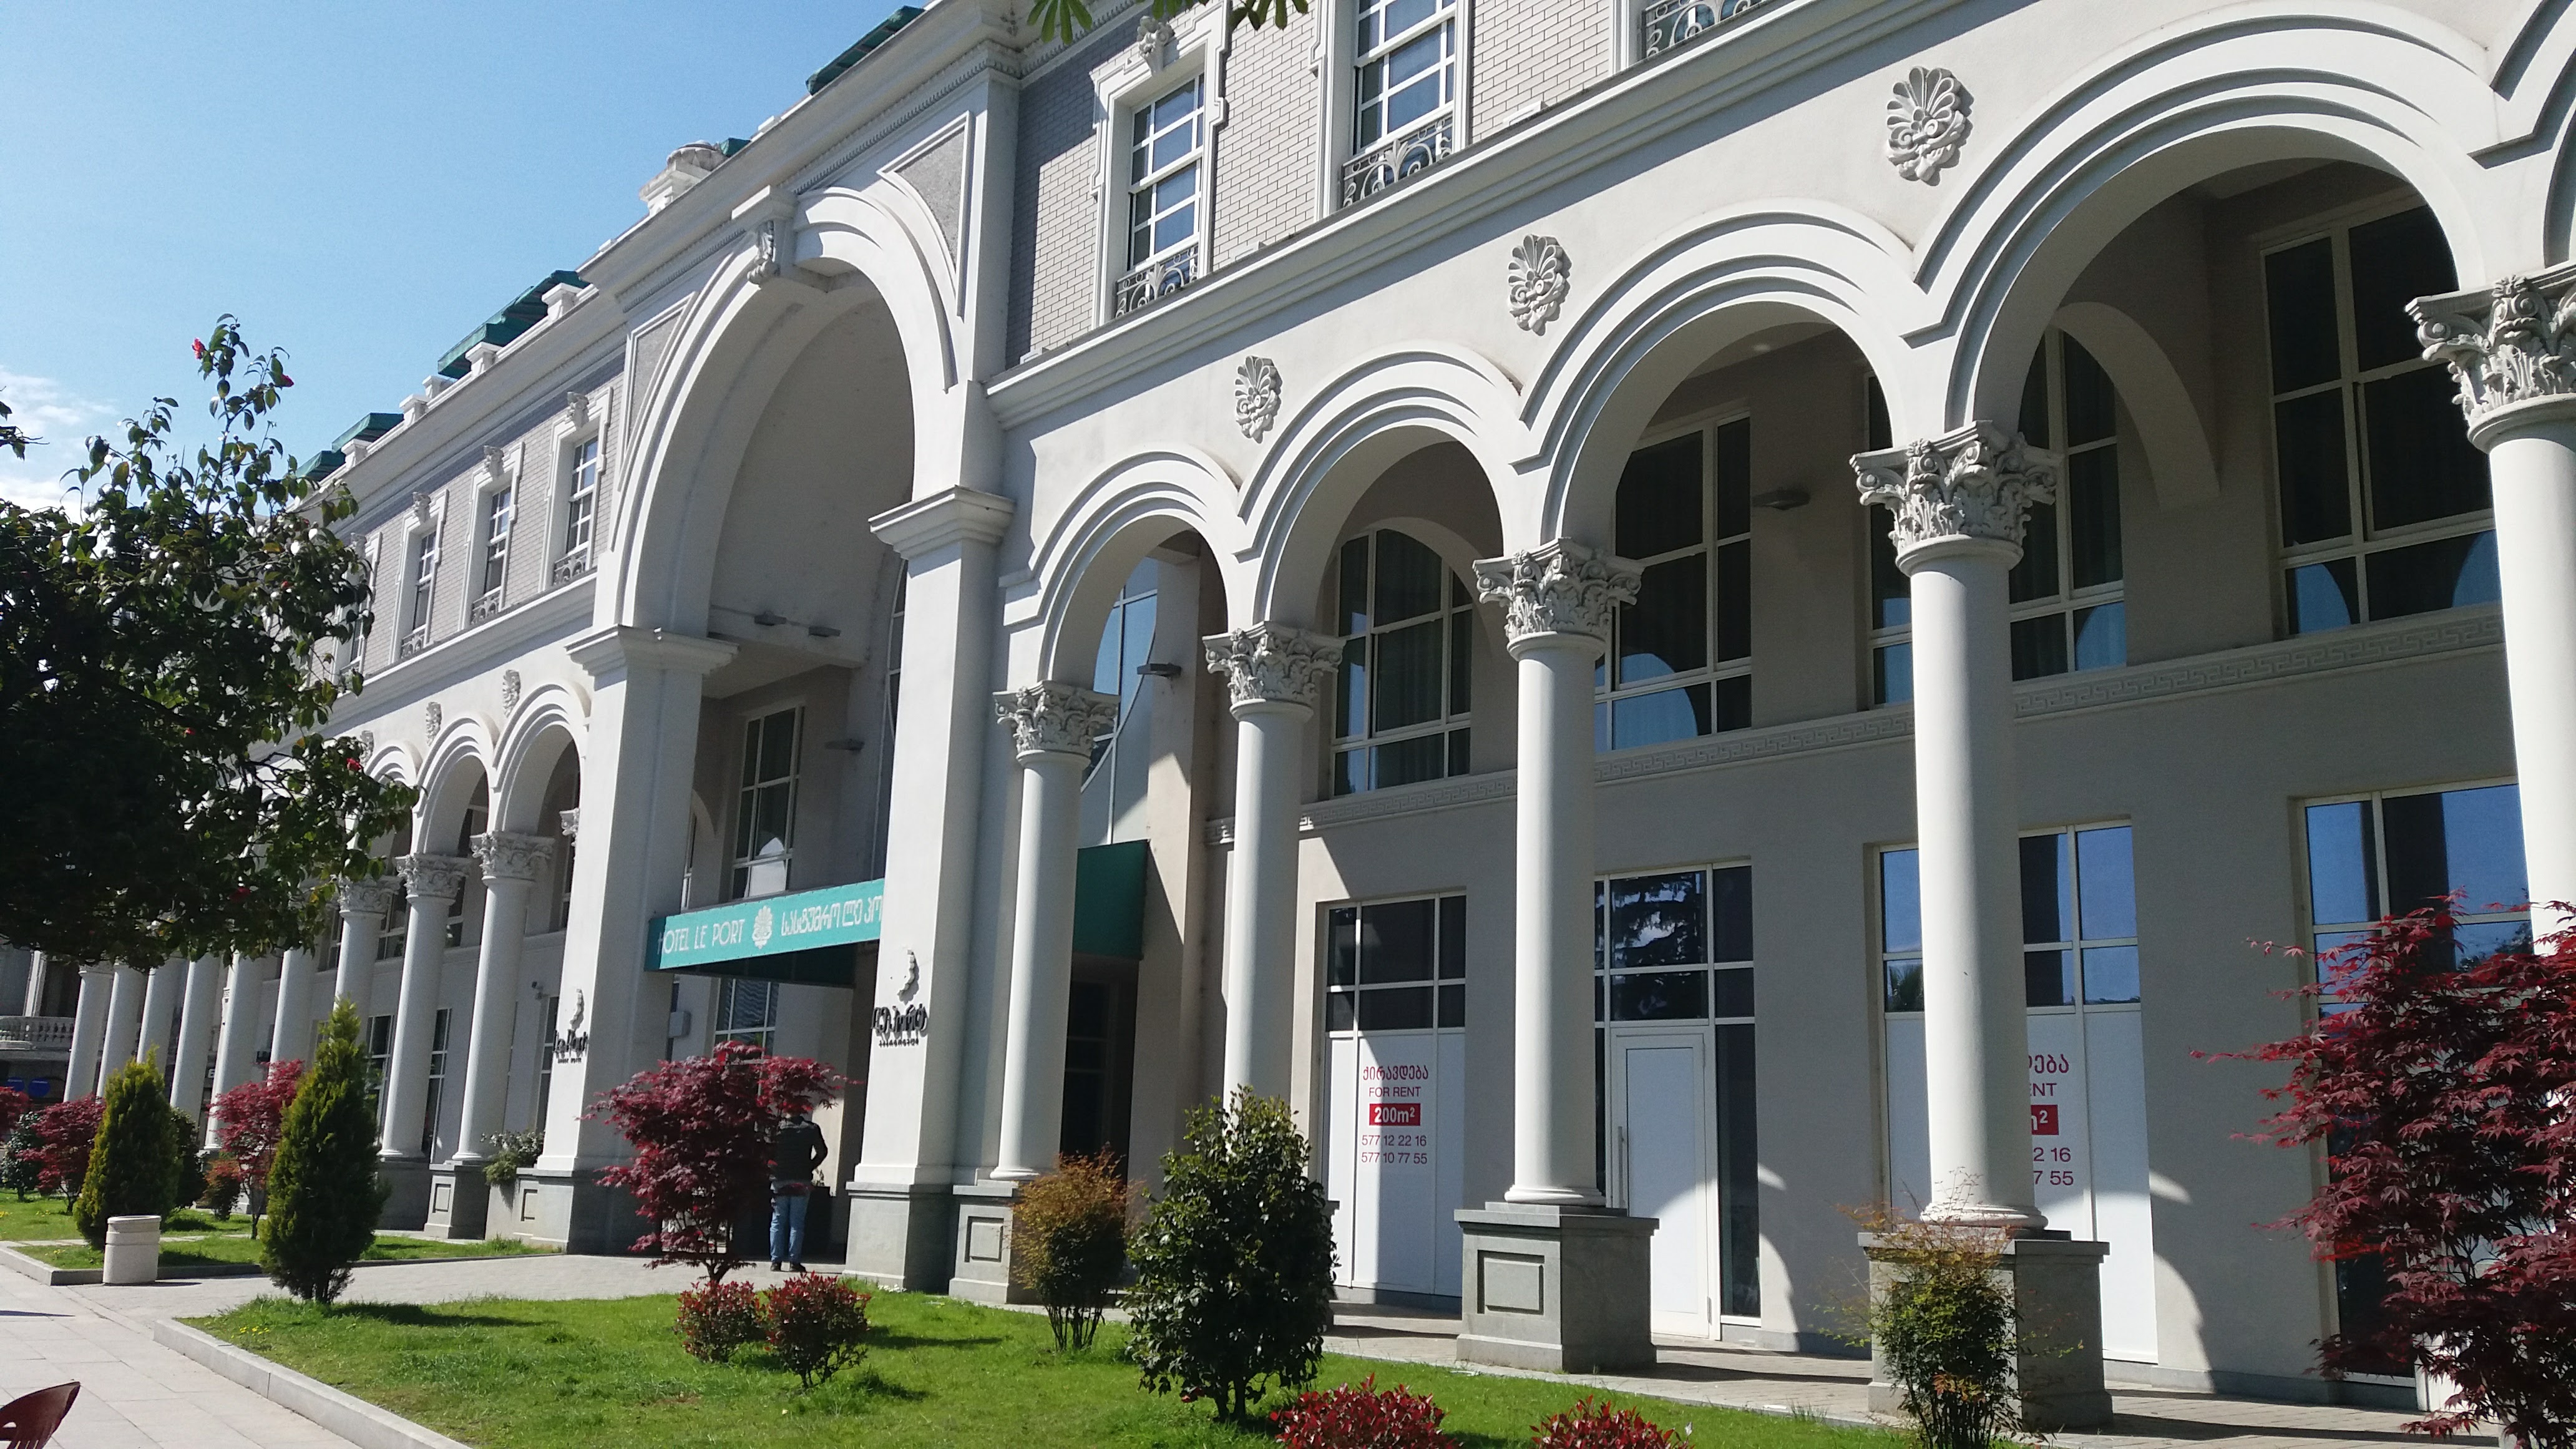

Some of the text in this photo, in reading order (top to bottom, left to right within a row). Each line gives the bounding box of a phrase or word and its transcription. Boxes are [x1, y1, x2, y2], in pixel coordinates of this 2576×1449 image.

[657, 919, 745, 955] HOTEL LE PORT
[1363, 1065, 1428, 1080] ქირავდება
[1369, 1086, 1422, 1097] FOR RENT
[1362, 1135, 1427, 1147] 577 12 22 16
[1361, 1152, 1428, 1164] 577 10 77 55
[2051, 1147, 2071, 1163] 16
[2050, 1171, 2074, 1186] 55
